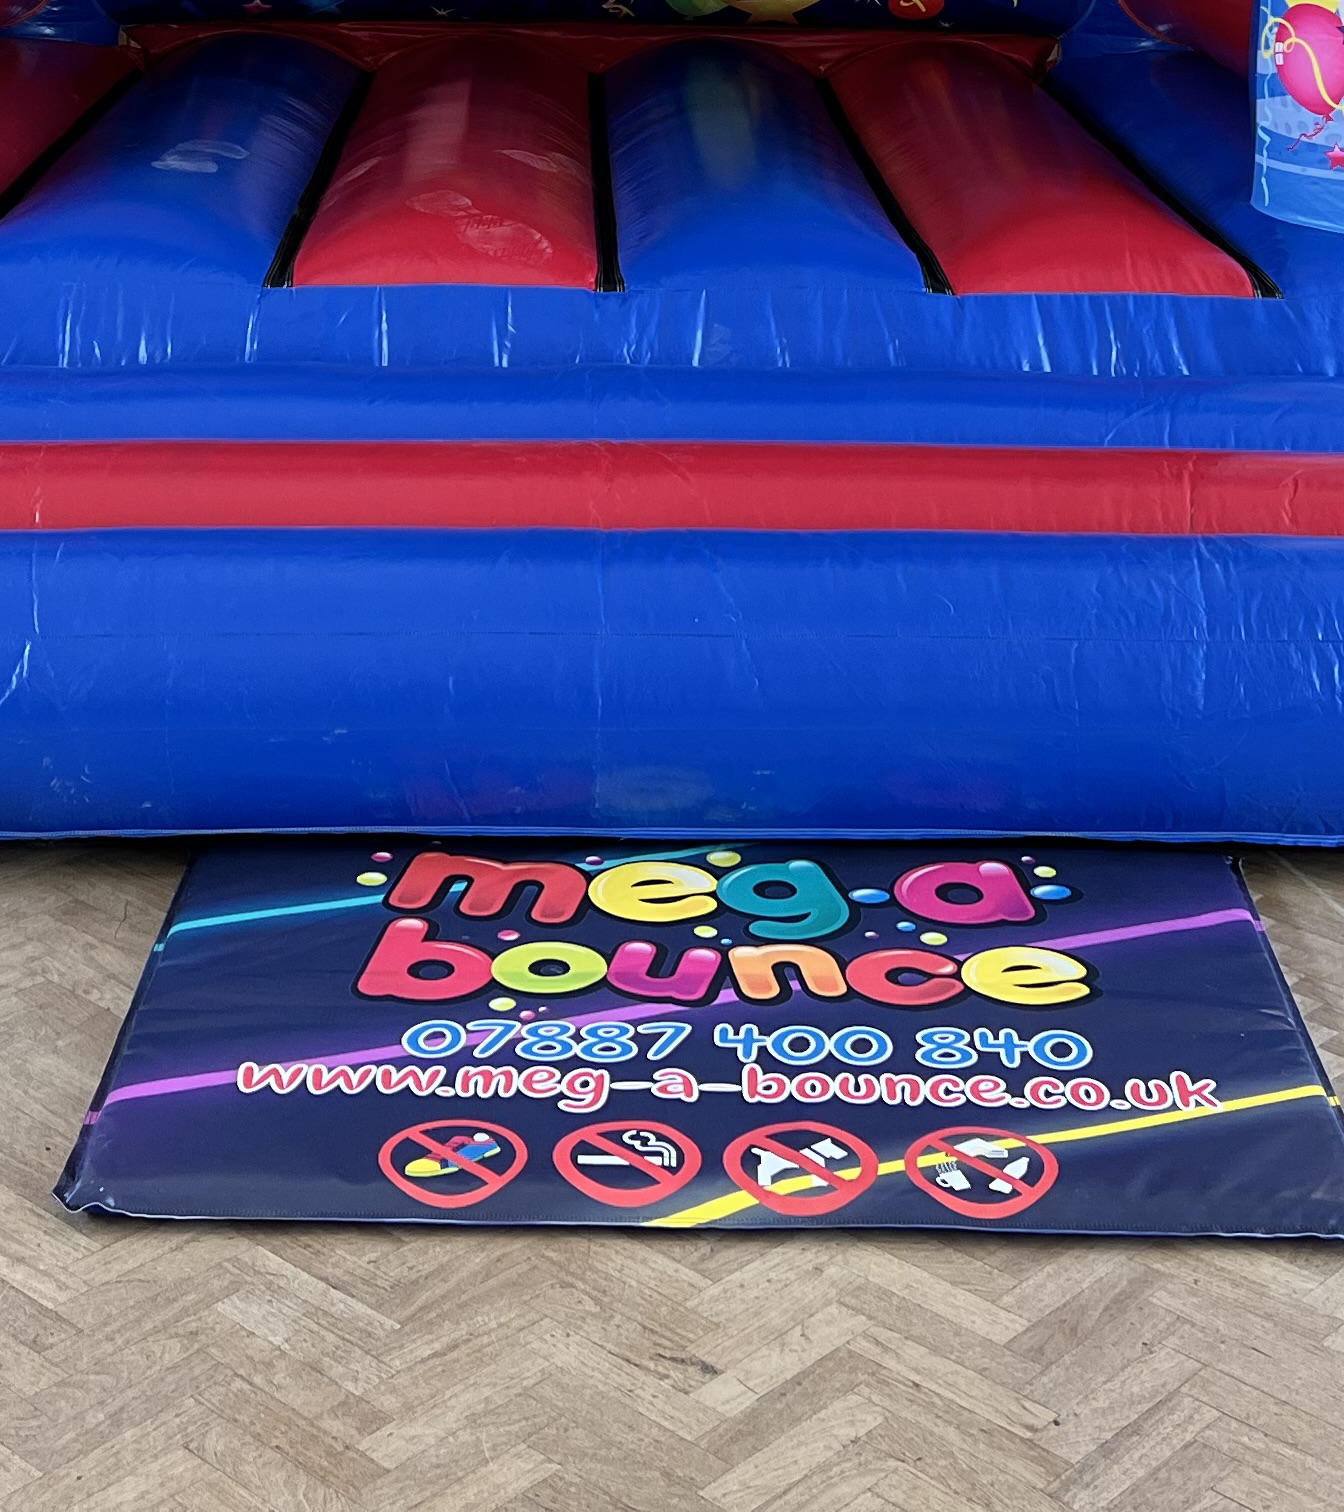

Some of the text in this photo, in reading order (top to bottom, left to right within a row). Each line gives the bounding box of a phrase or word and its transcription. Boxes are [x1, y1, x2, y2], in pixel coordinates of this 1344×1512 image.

[356, 917, 1092, 1006] bounce
[400, 1018, 1094, 1070] 07887 400 840
[236, 1061, 1223, 1114] www.meg-a-bounce.co.uk
